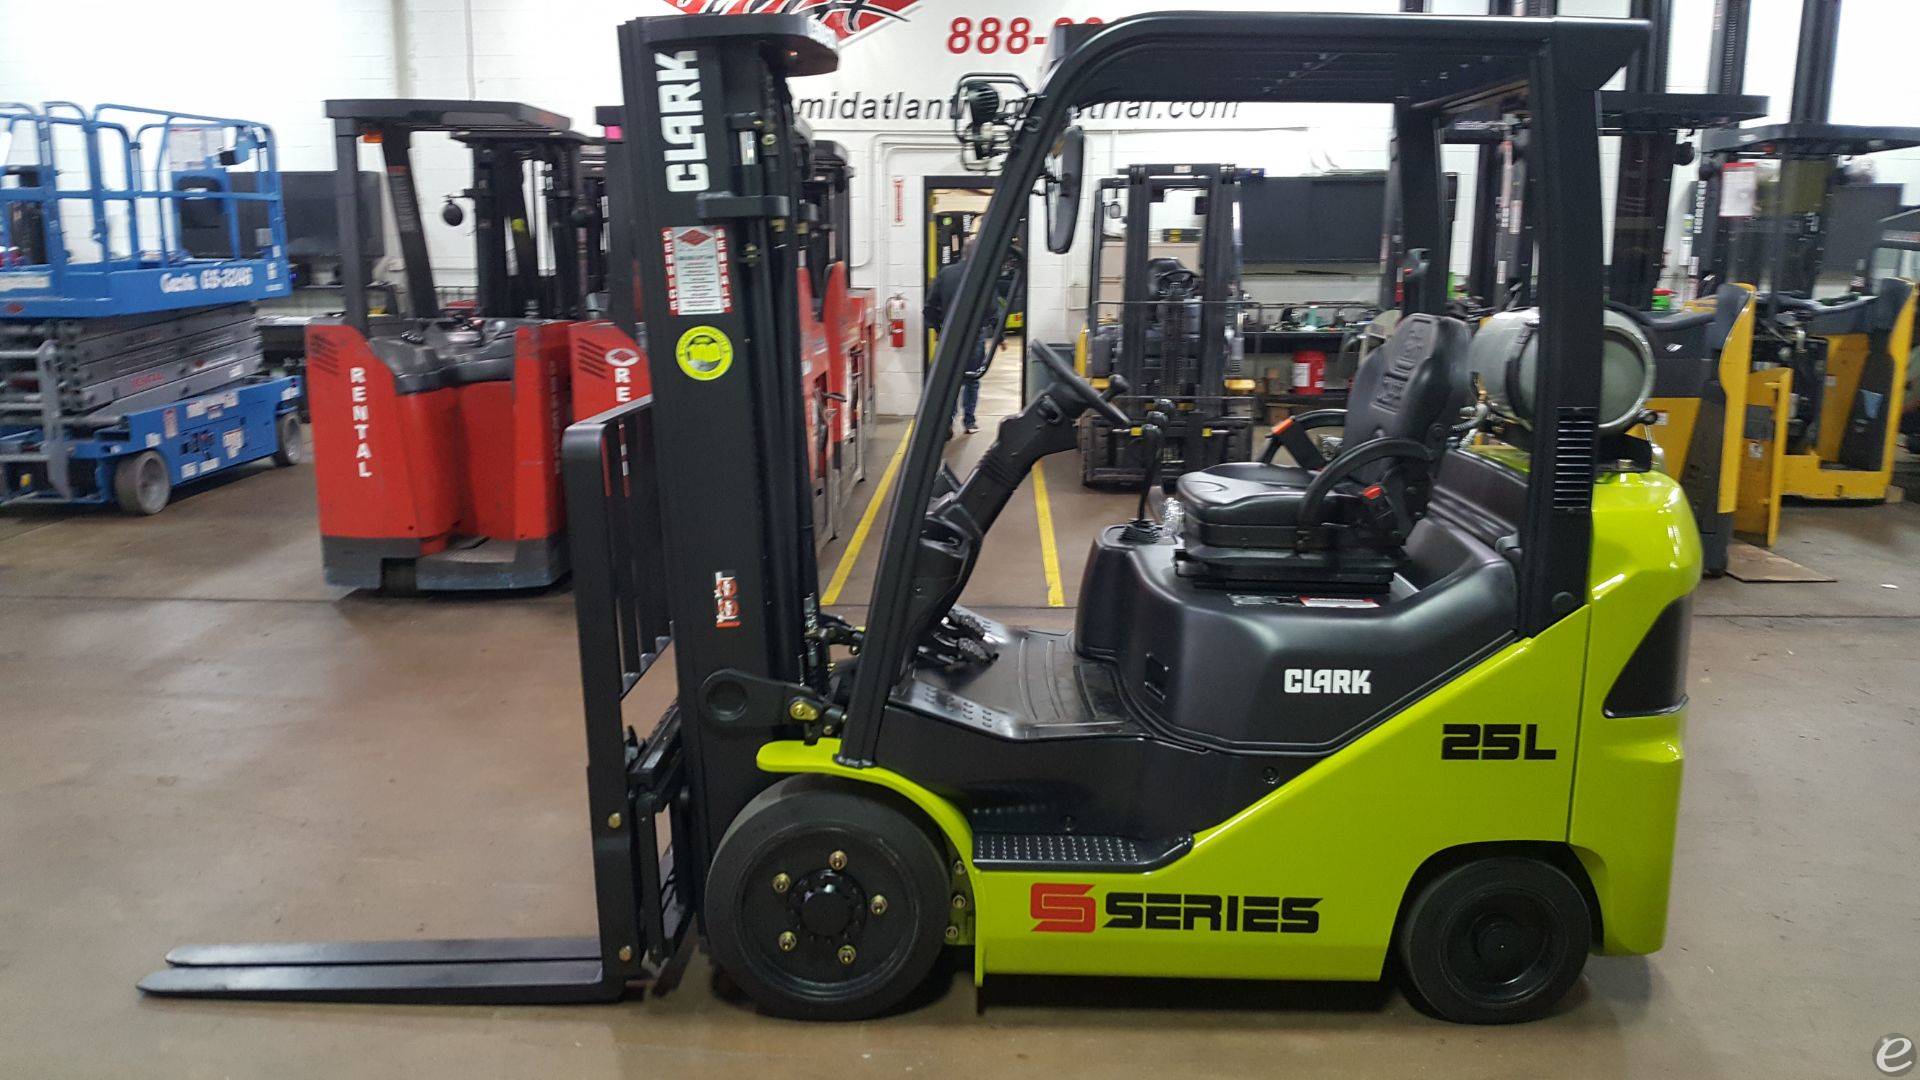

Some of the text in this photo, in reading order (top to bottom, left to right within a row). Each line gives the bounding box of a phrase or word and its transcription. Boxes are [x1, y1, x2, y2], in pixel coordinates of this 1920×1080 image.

[654, 50, 710, 192] CLARK
[614, 367, 631, 402] RE
[350, 367, 372, 477] RENTAL
[1284, 669, 1371, 694] CLARK
[1441, 723, 1557, 760] 25L
[1102, 892, 1323, 933] SERIES
